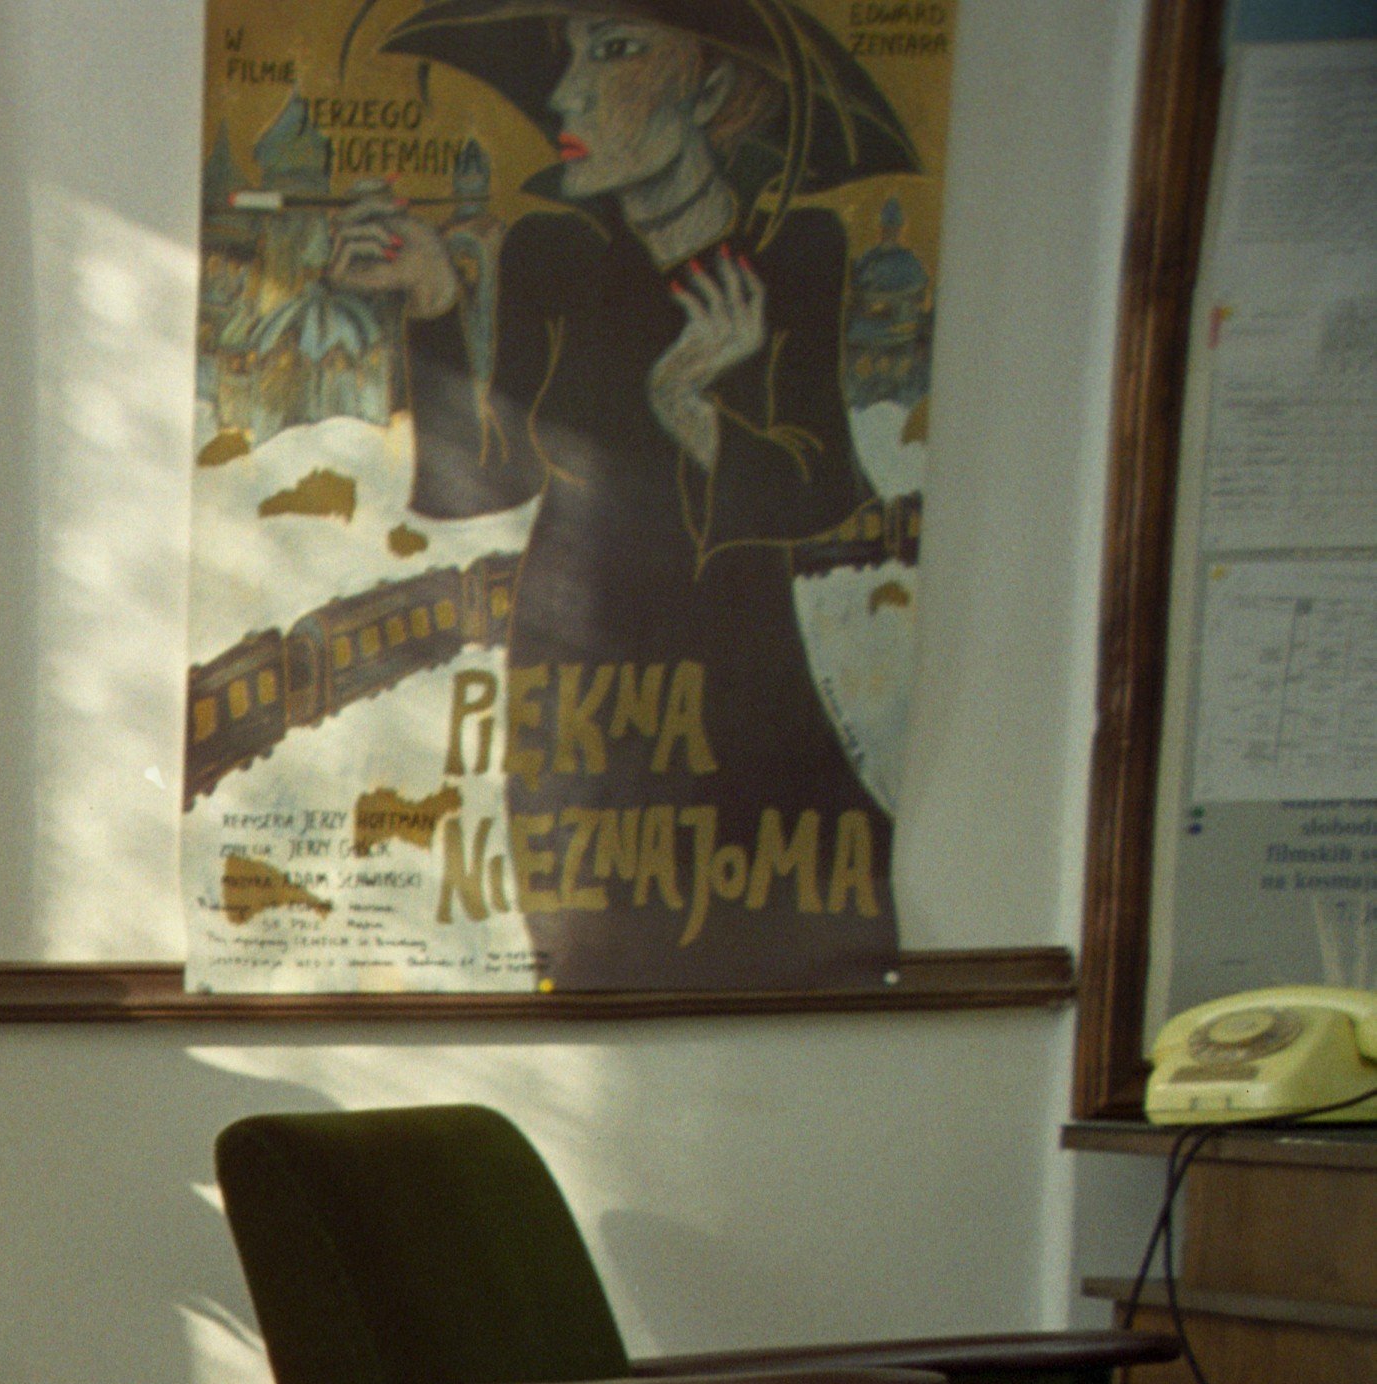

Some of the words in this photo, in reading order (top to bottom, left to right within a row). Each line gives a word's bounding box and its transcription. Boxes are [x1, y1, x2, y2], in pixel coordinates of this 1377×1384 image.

[226, 57, 295, 83] FILMIE
[298, 97, 421, 136] JERZEGO
[323, 136, 486, 177] HOFFMANA
